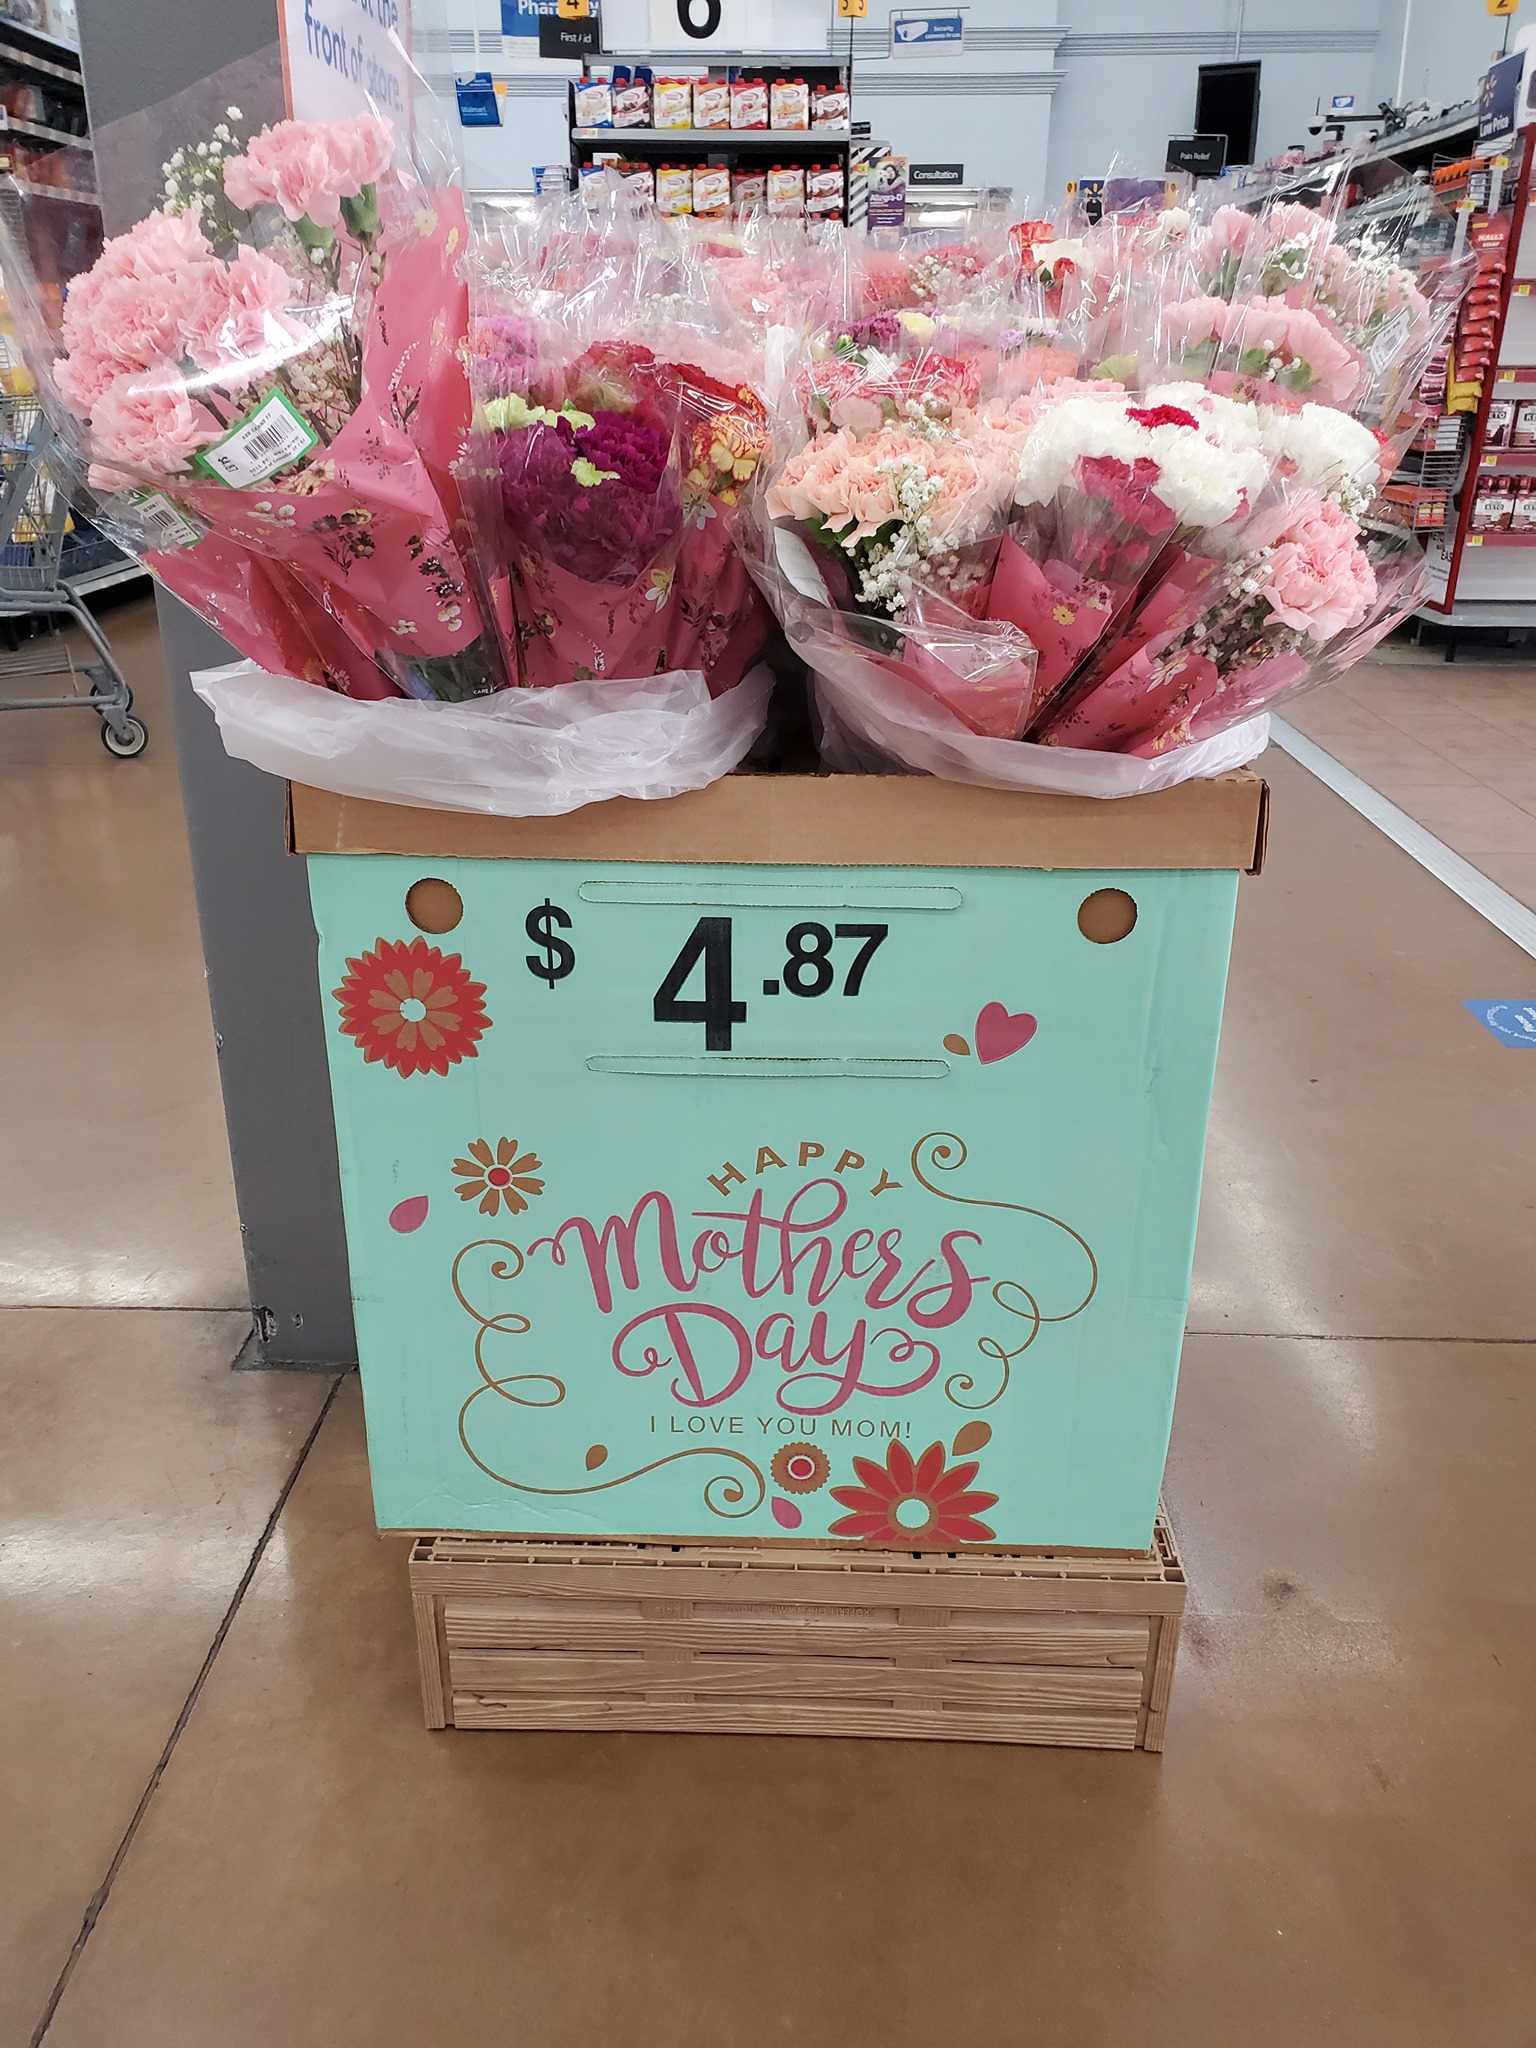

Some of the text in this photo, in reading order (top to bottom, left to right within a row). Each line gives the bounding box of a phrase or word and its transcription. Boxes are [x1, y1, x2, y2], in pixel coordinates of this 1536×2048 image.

[304, 0, 348, 78] front
[351, 34, 363, 84] of
[913, 169, 959, 180] Consultation
[525, 897, 576, 989] $
[707, 1142, 903, 1197] HAPPY
[527, 1178, 991, 1328] Mothers
[612, 1302, 941, 1415] Day
[651, 1416, 911, 1438] I LOVE YOU MOM!
